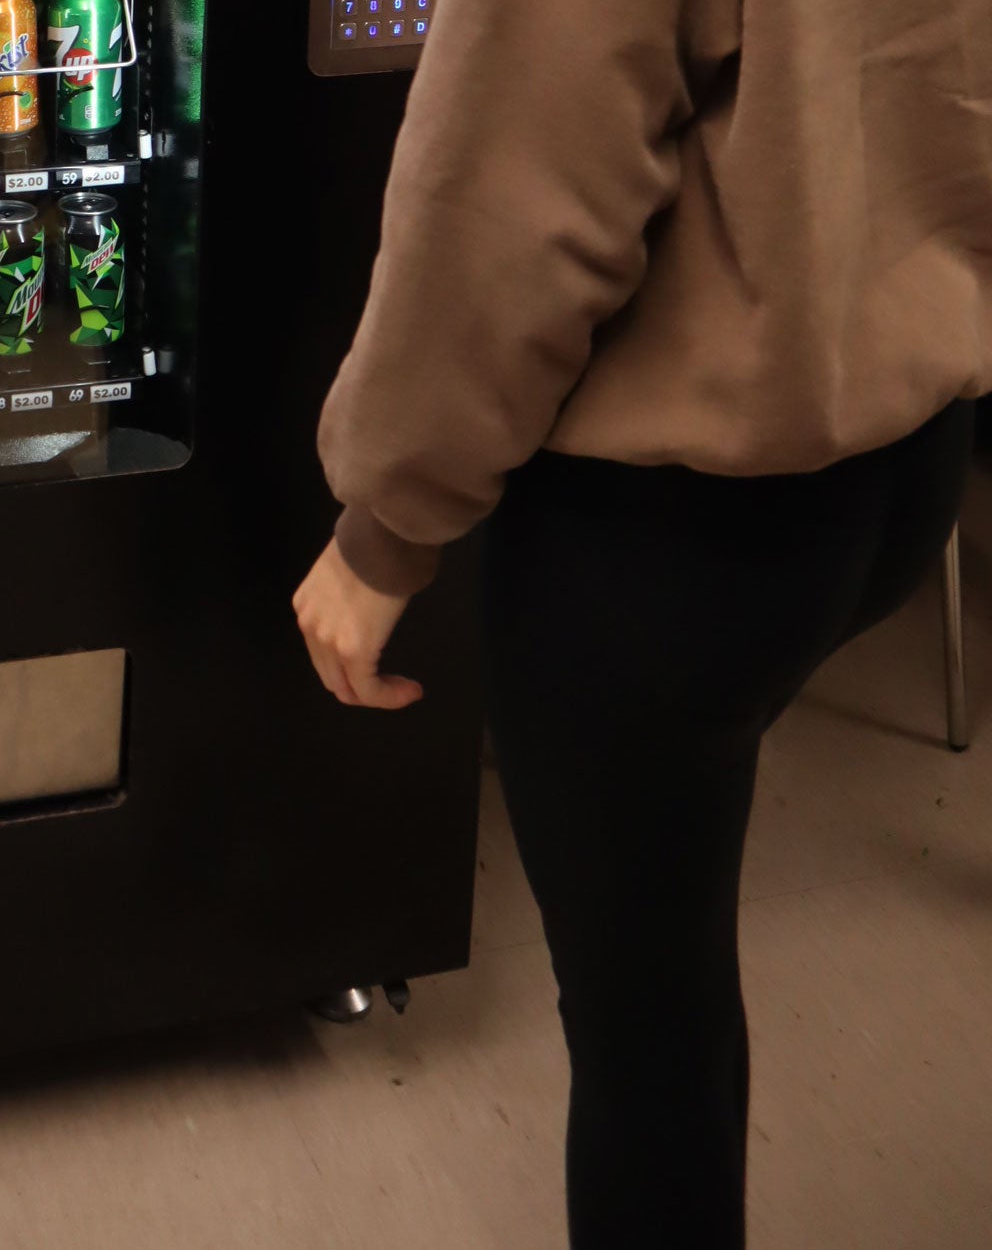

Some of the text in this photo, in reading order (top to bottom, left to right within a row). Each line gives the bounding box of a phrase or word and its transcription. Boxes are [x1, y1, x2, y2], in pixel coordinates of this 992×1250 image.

[62, 172, 78, 185] 59
[14, 396, 49, 407] $2.00
[69, 389, 84, 402] 69
